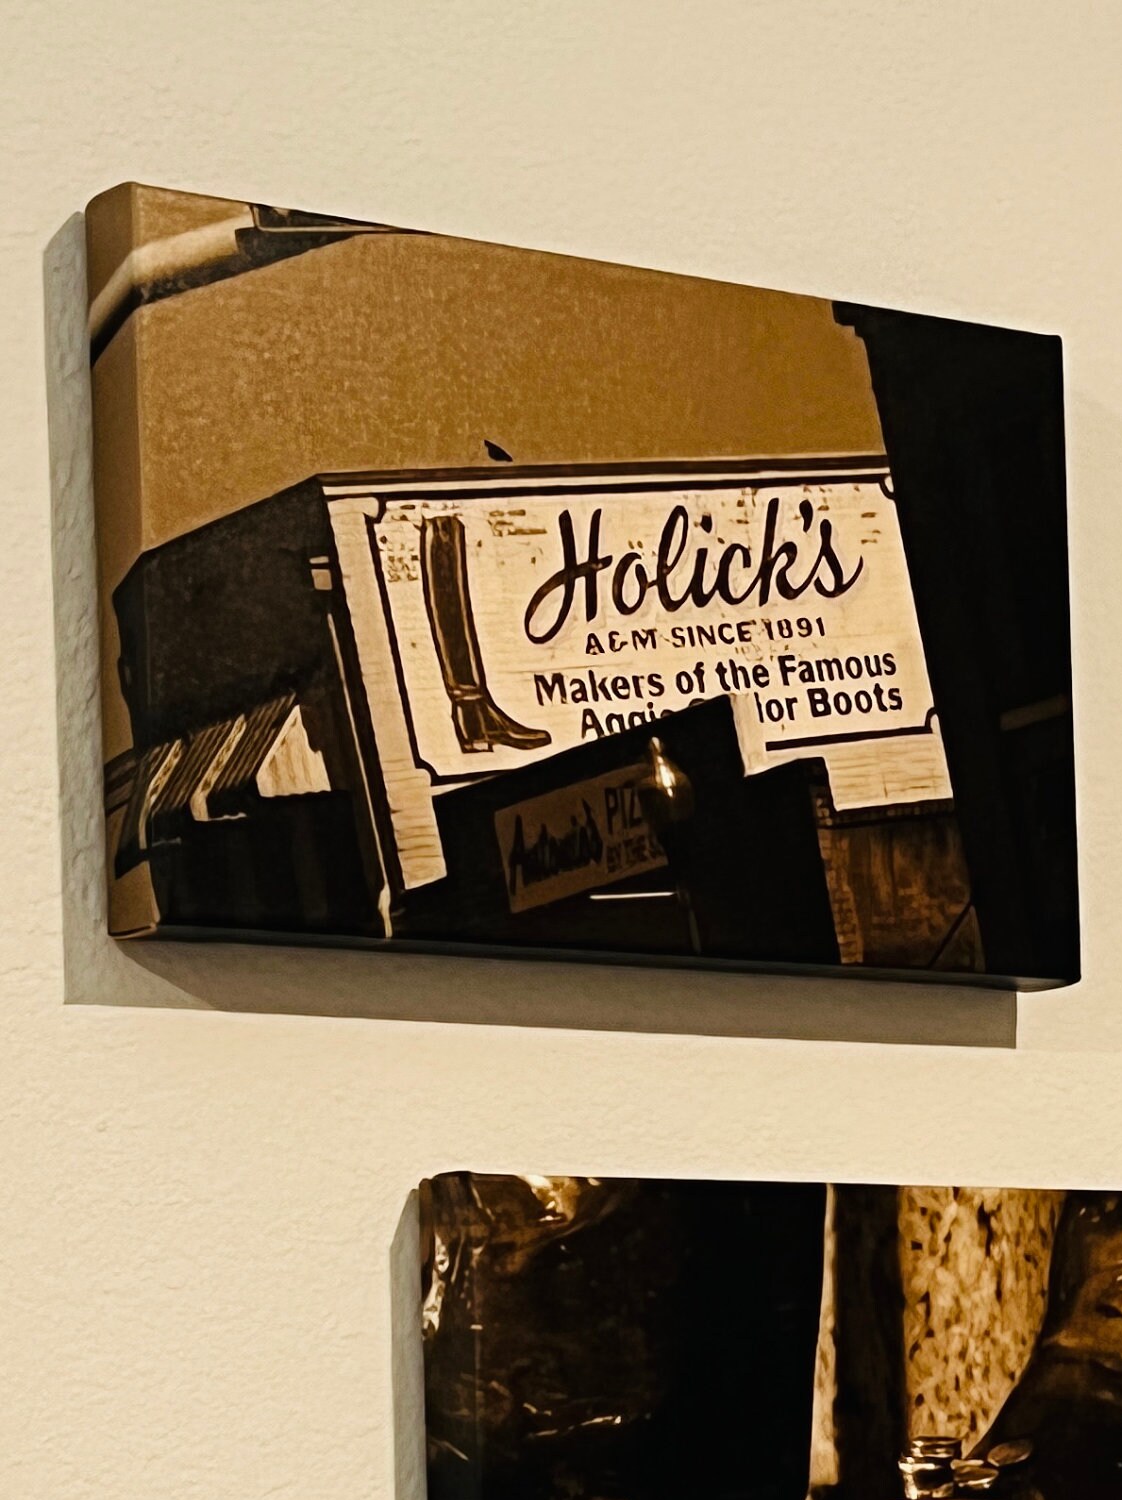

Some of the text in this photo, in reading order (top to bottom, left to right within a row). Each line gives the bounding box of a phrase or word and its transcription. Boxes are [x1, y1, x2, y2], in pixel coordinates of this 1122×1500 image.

[524, 497, 864, 645] Holick's
[585, 616, 826, 655] A&M SINCE 1891
[534, 651, 897, 706] Makers of the Famous
[806, 682, 903, 718] Boots
